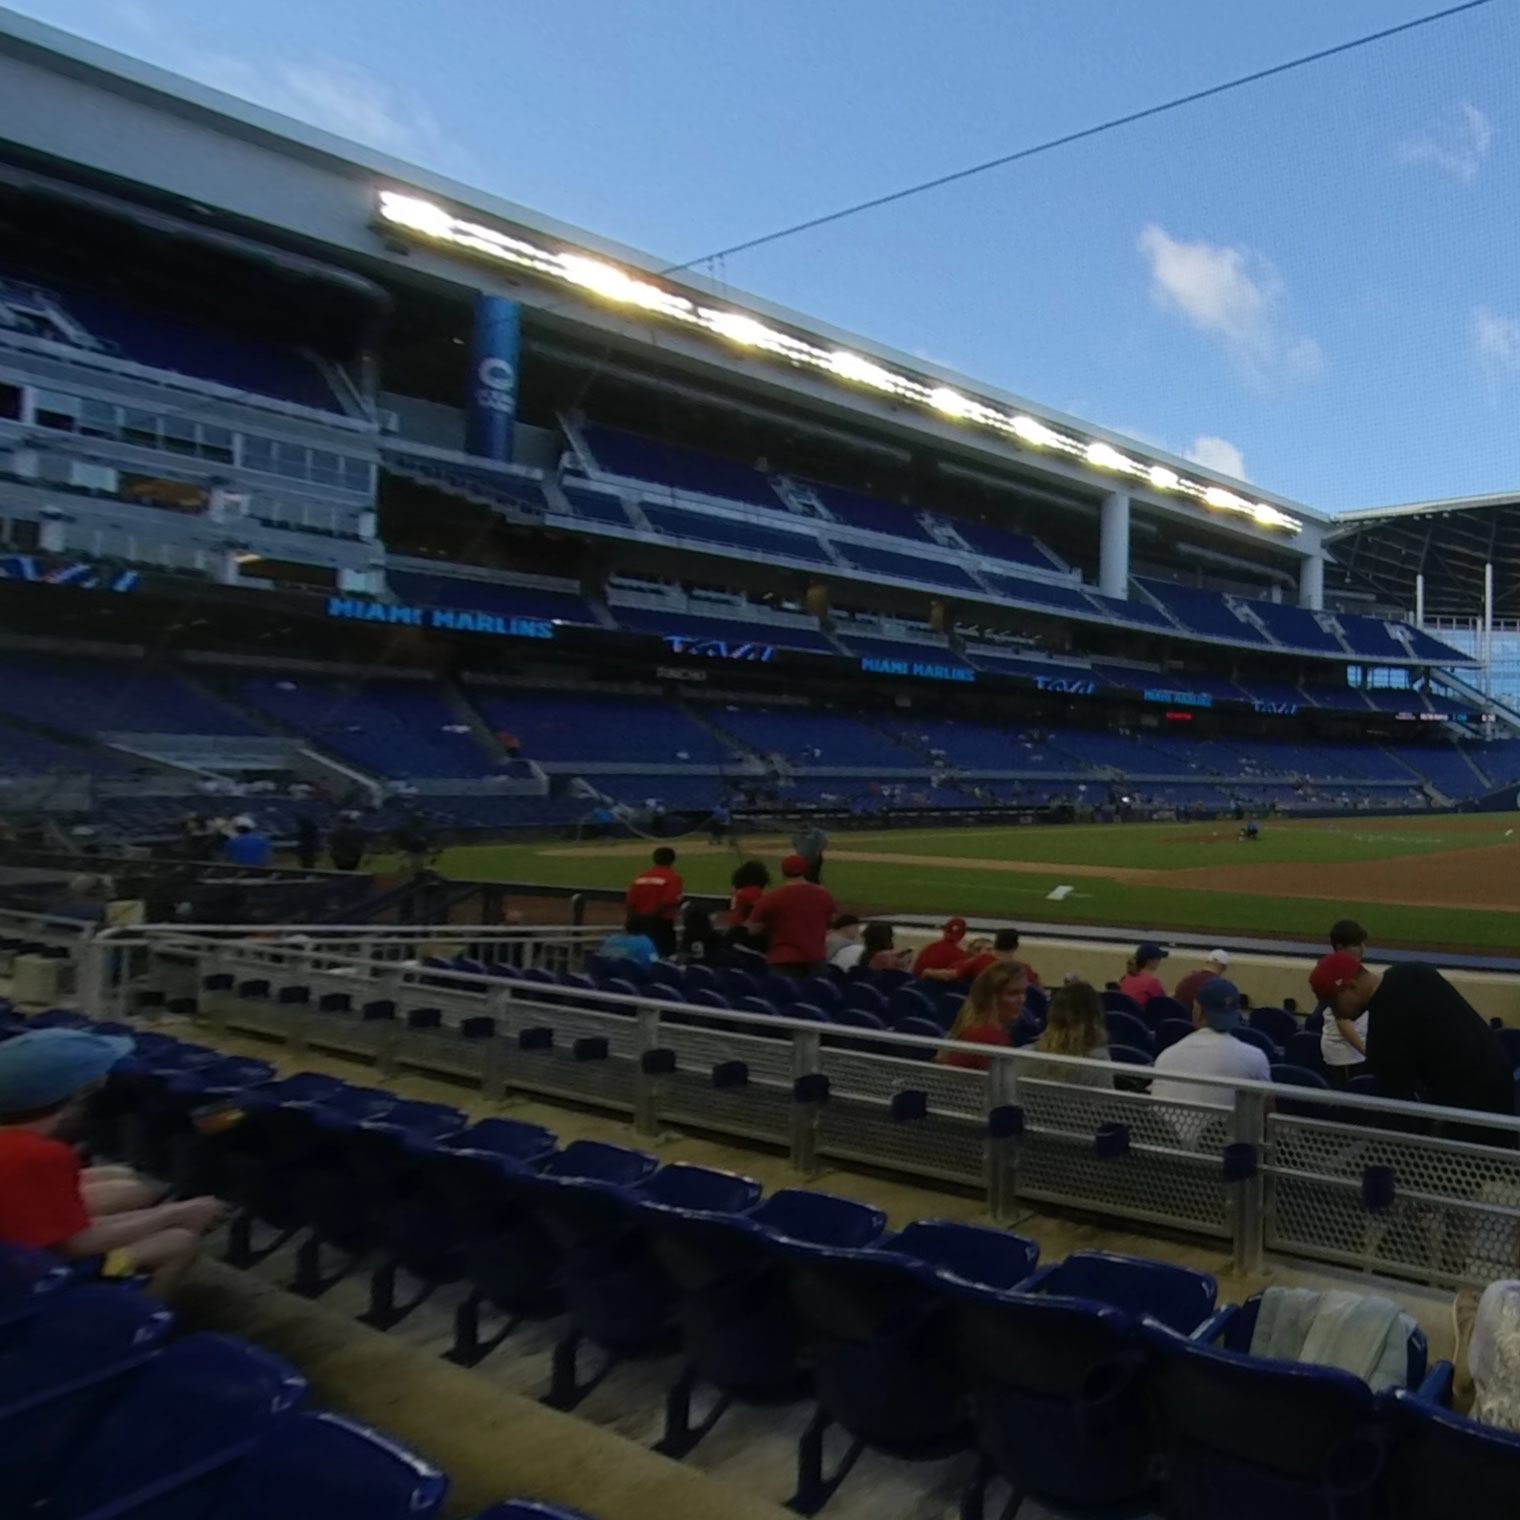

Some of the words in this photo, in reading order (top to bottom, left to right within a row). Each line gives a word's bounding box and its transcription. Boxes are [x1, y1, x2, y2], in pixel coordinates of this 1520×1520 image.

[328, 597, 422, 625] MIAMI
[432, 609, 555, 639] MARLINS
[861, 657, 908, 675] MIAMI
[913, 664, 975, 682] MARLINS
